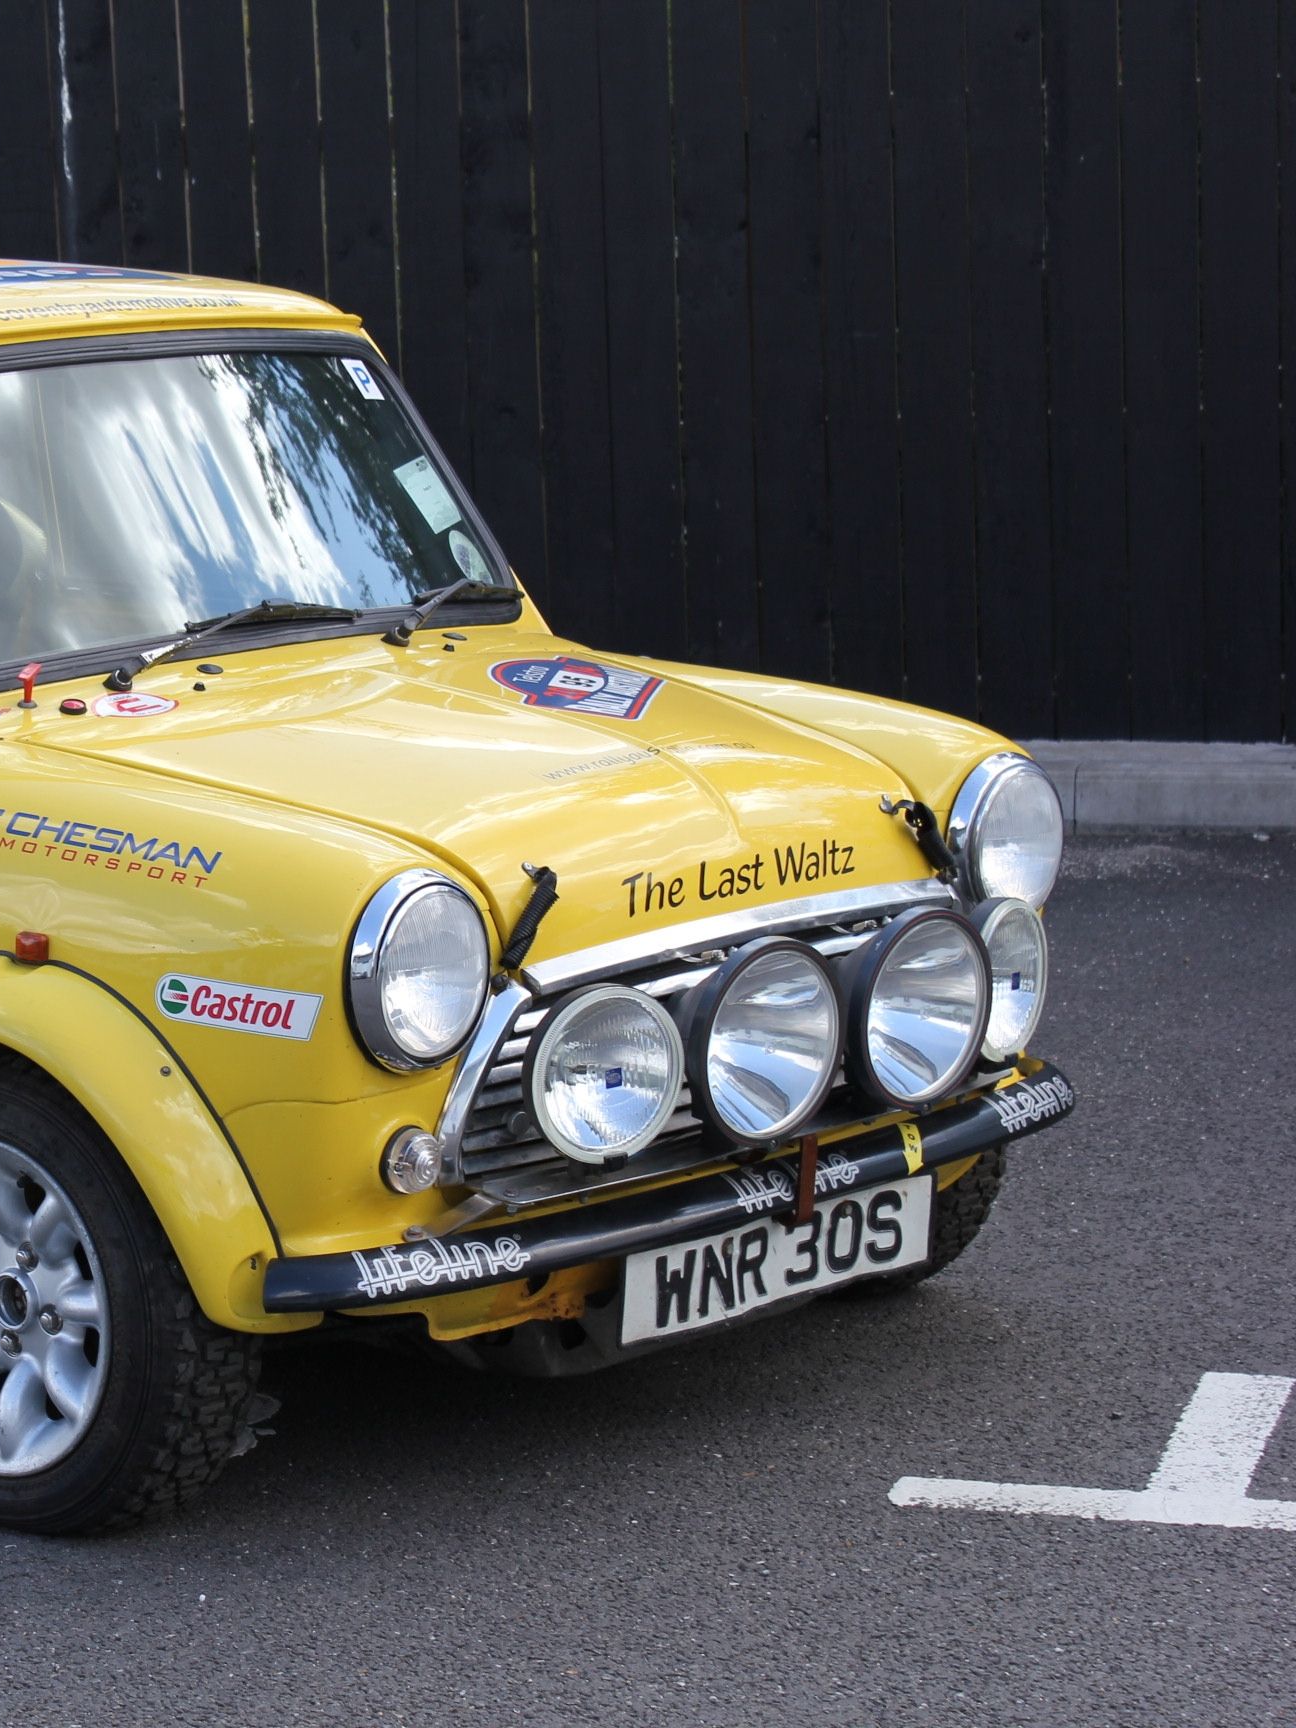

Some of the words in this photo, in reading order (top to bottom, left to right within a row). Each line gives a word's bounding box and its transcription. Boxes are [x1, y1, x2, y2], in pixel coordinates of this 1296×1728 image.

[5, 811, 223, 874] CHESMAN
[622, 871, 686, 918] The
[698, 853, 765, 901] Last
[774, 838, 855, 887] Waltz
[190, 985, 295, 1030] Castrol
[721, 1153, 859, 1214] lifelne
[656, 1226, 768, 1329] WNR
[784, 1189, 902, 1287] 30S
